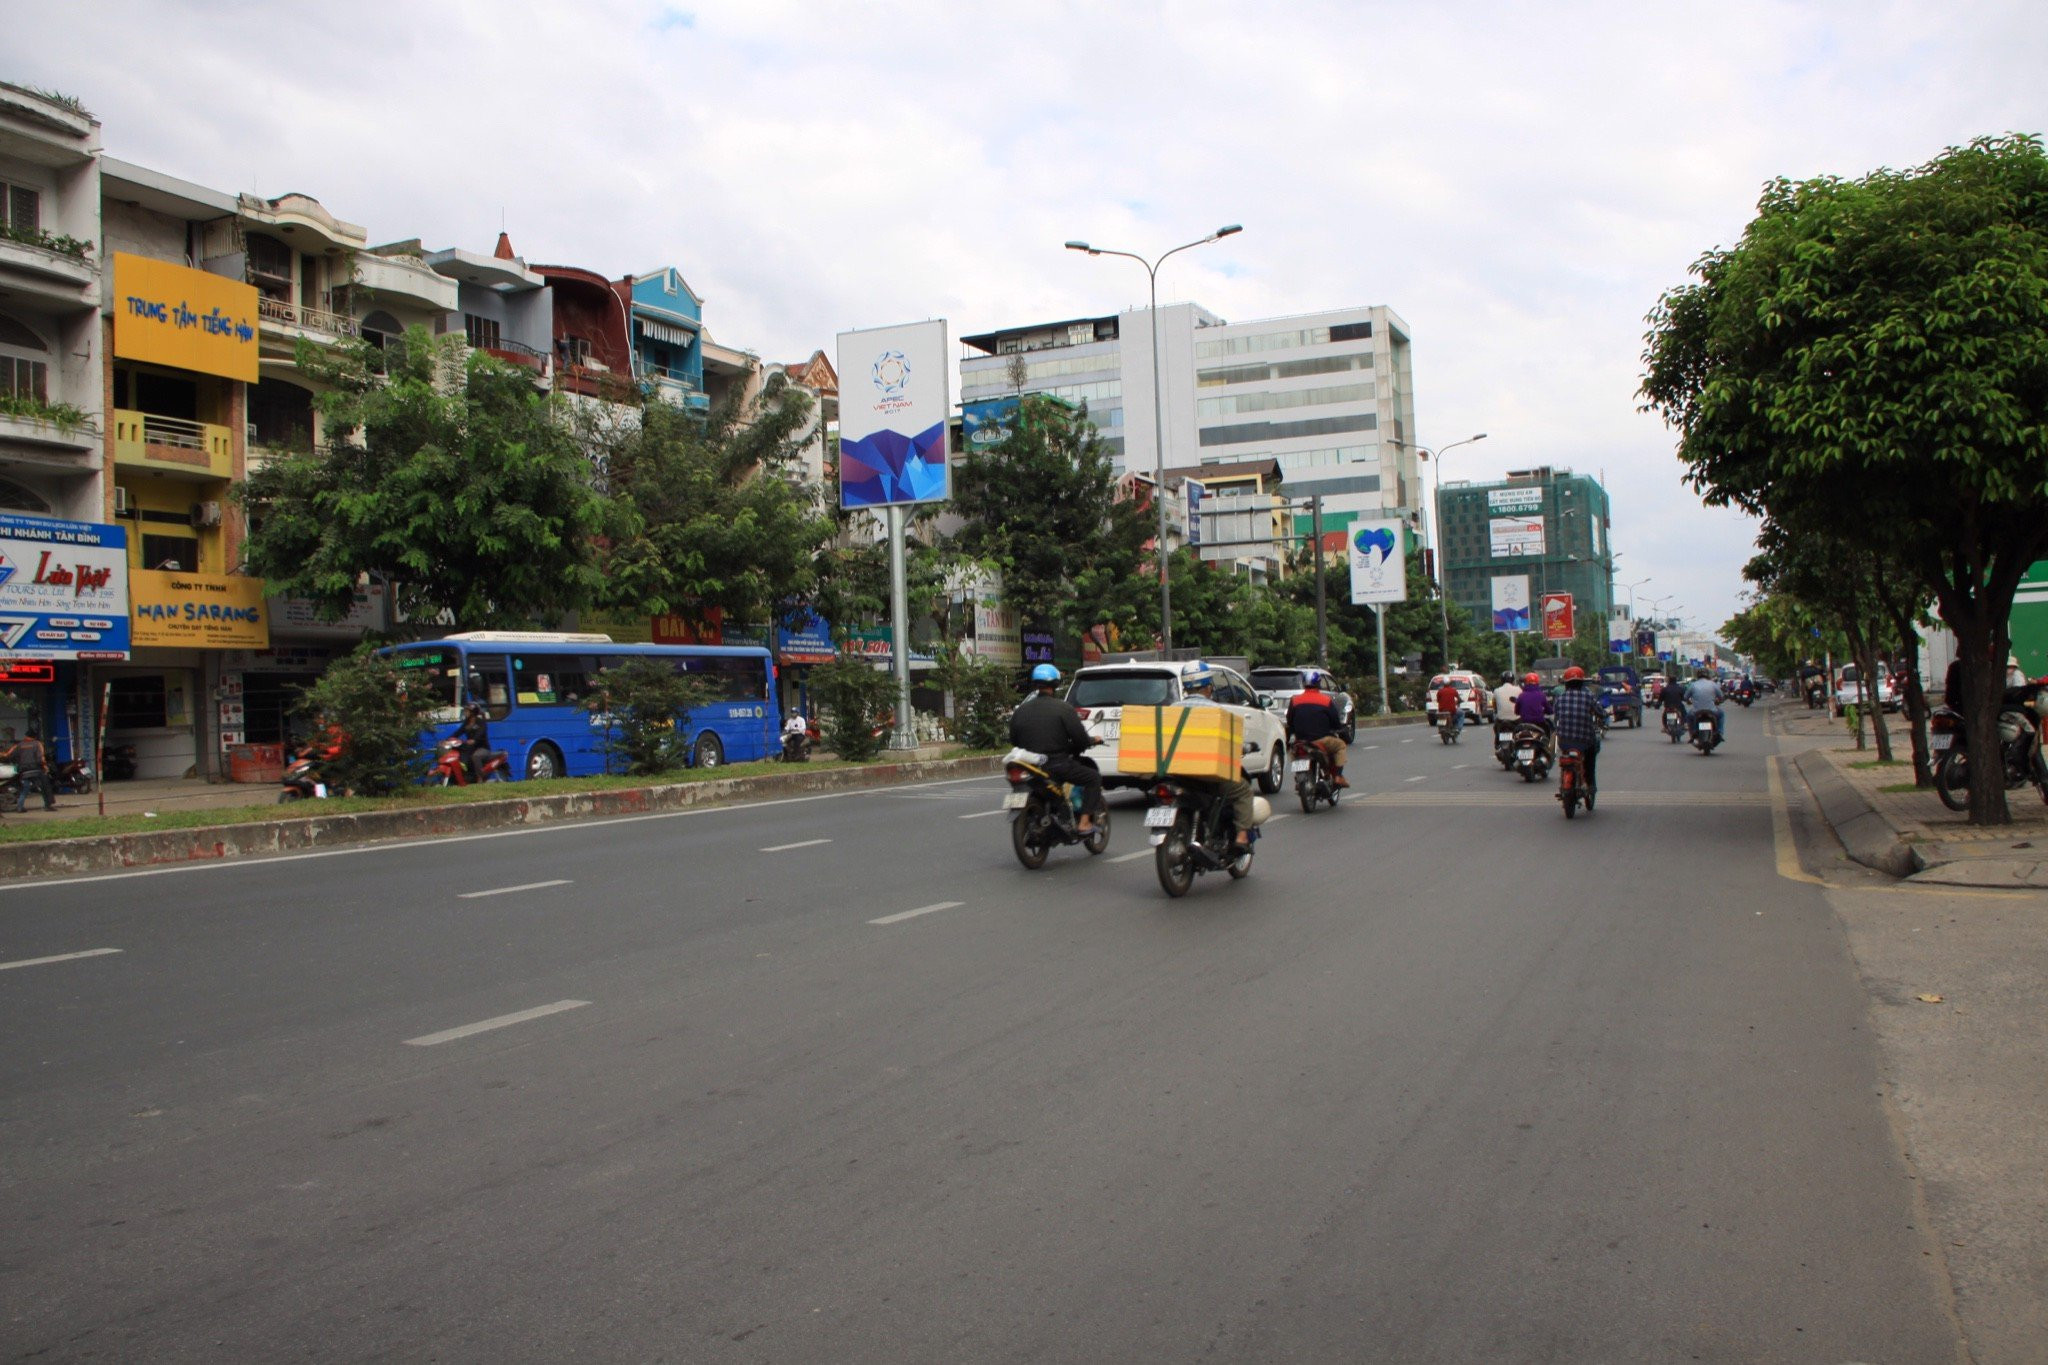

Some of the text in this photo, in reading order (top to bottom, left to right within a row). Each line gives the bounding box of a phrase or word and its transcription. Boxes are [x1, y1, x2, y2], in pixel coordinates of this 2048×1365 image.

[127, 296, 167, 323] TRUNG
[172, 300, 197, 330] TÂM
[201, 306, 232, 336] TIẾNG
[881, 395, 904, 403] APEC
[0, 527, 100, 543] HI NHÁNH TÂN BÌNH
[32, 550, 73, 585] Lửa
[6, 584, 35, 595] TOURS
[171, 580, 227, 592] CÔNG TY TNHH
[137, 602, 260, 623] HAN SARANG
